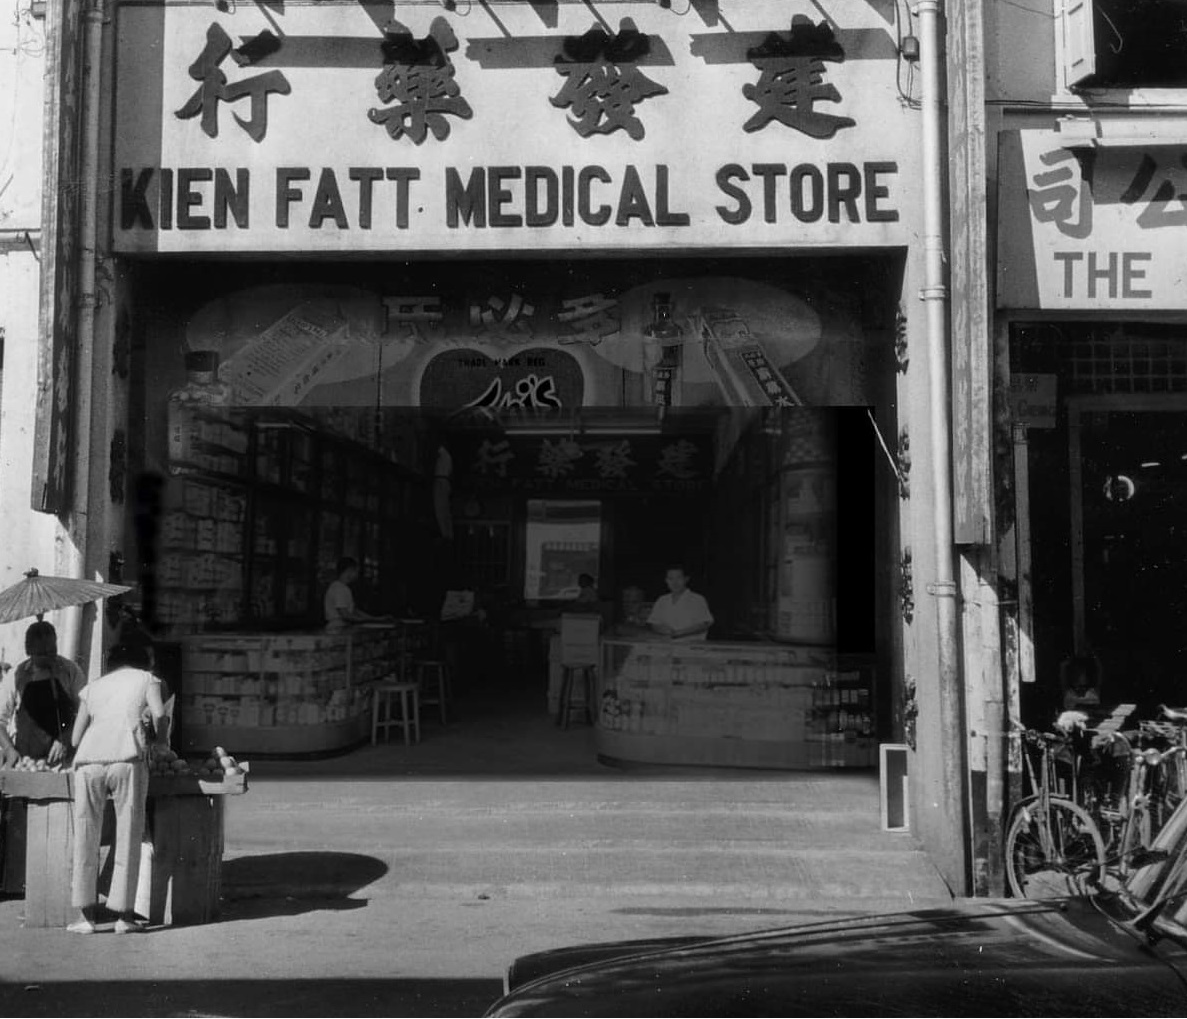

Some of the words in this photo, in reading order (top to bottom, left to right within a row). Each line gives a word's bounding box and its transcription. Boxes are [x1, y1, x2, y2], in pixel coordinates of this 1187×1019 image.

[120, 166, 250, 231] KIEN
[275, 166, 421, 230] FATT
[444, 164, 691, 229] MEDICAL
[715, 161, 900, 225] STORE
[1053, 251, 1153, 299] THE
